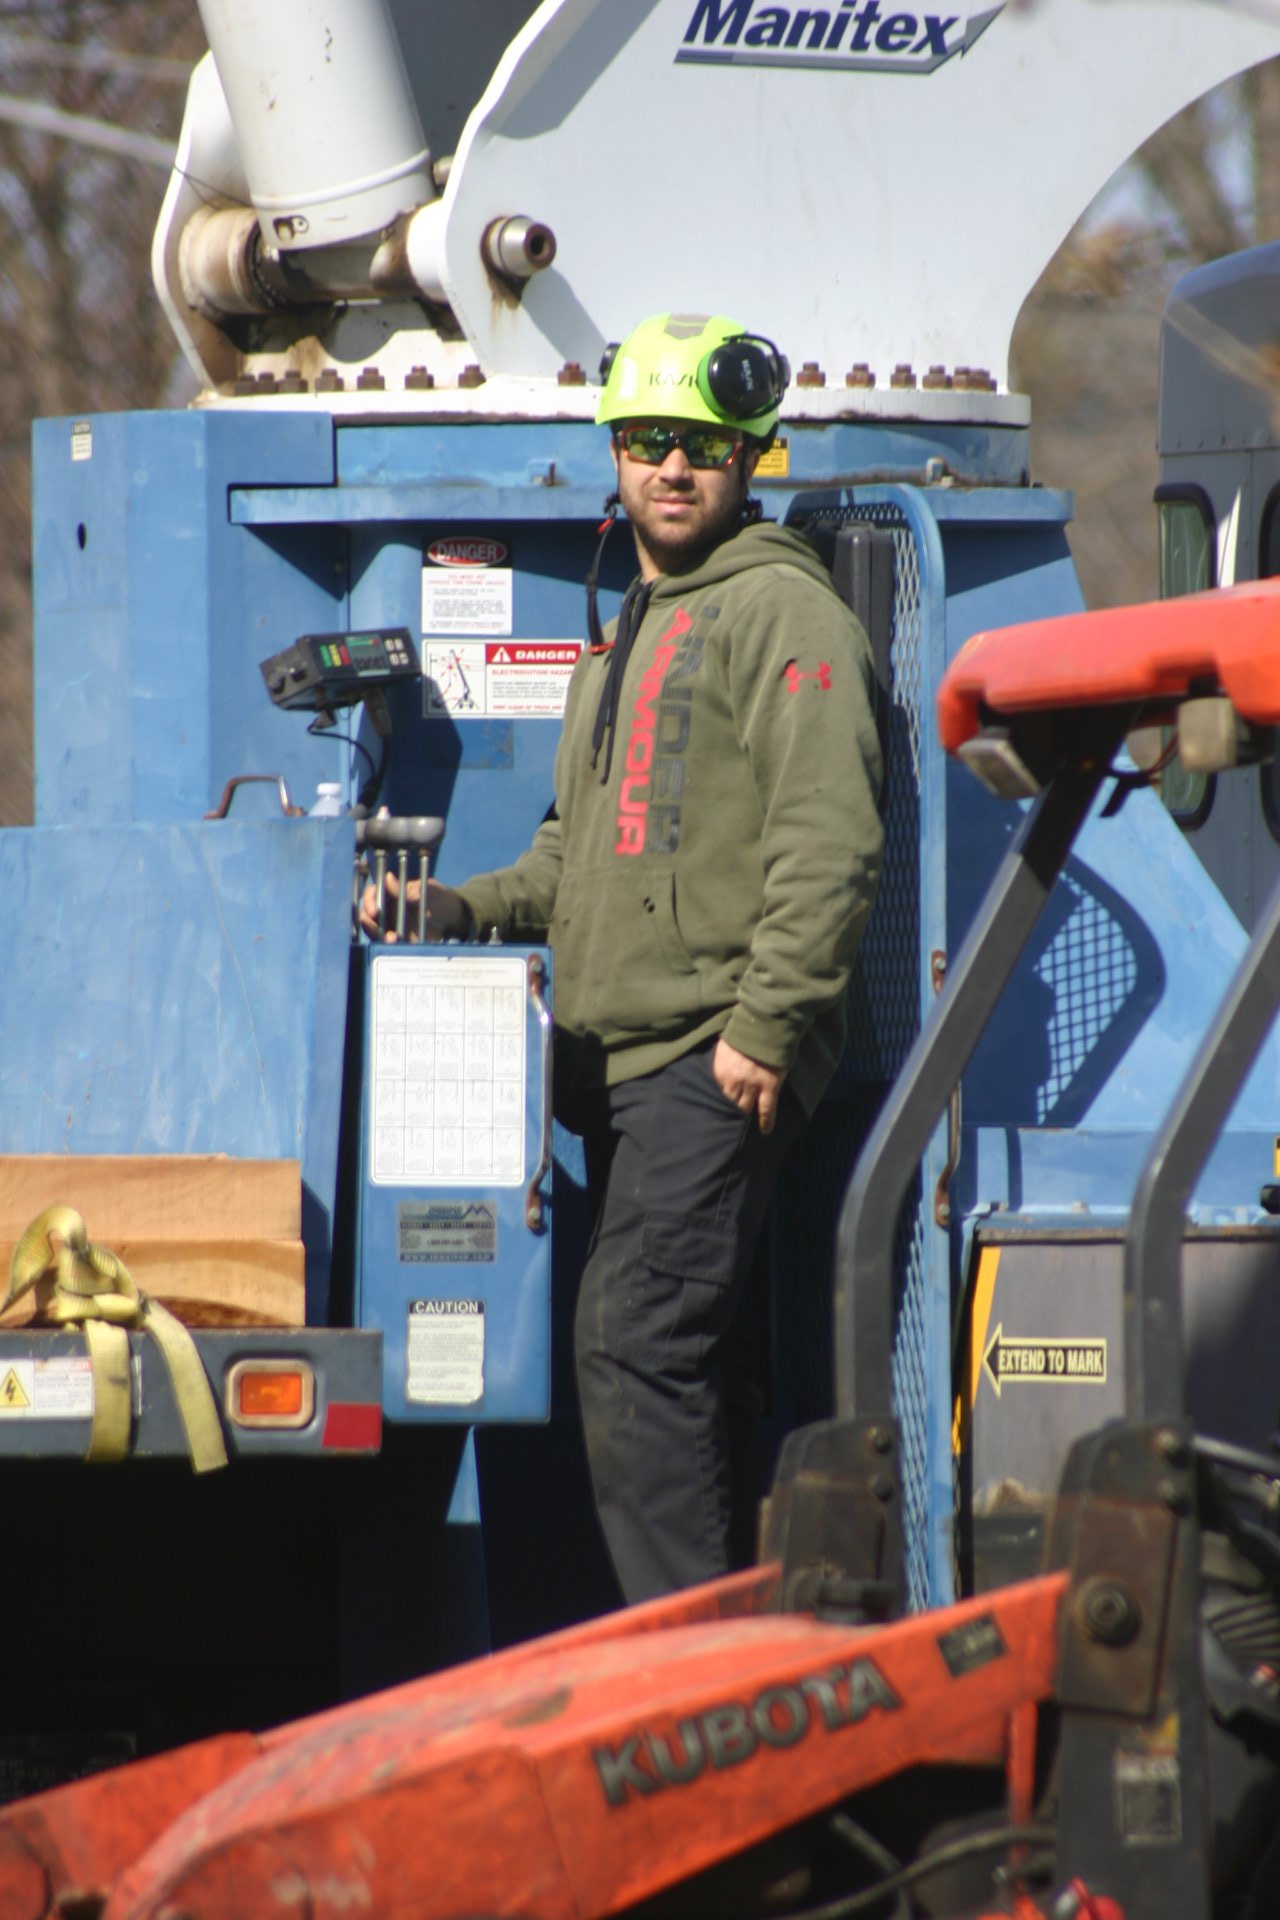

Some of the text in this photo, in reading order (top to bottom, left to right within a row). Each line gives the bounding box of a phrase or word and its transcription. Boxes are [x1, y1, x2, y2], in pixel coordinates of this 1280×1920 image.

[682, 0, 959, 56] Manitex
[437, 543, 497, 560] DANGER
[515, 650, 577, 660] DANGER
[614, 607, 693, 856] ARMOUR
[415, 1301, 478, 1314] CAUTION
[999, 1349, 1102, 1374] EXTEND TO MARK
[592, 1655, 899, 1806] KUBOTA
